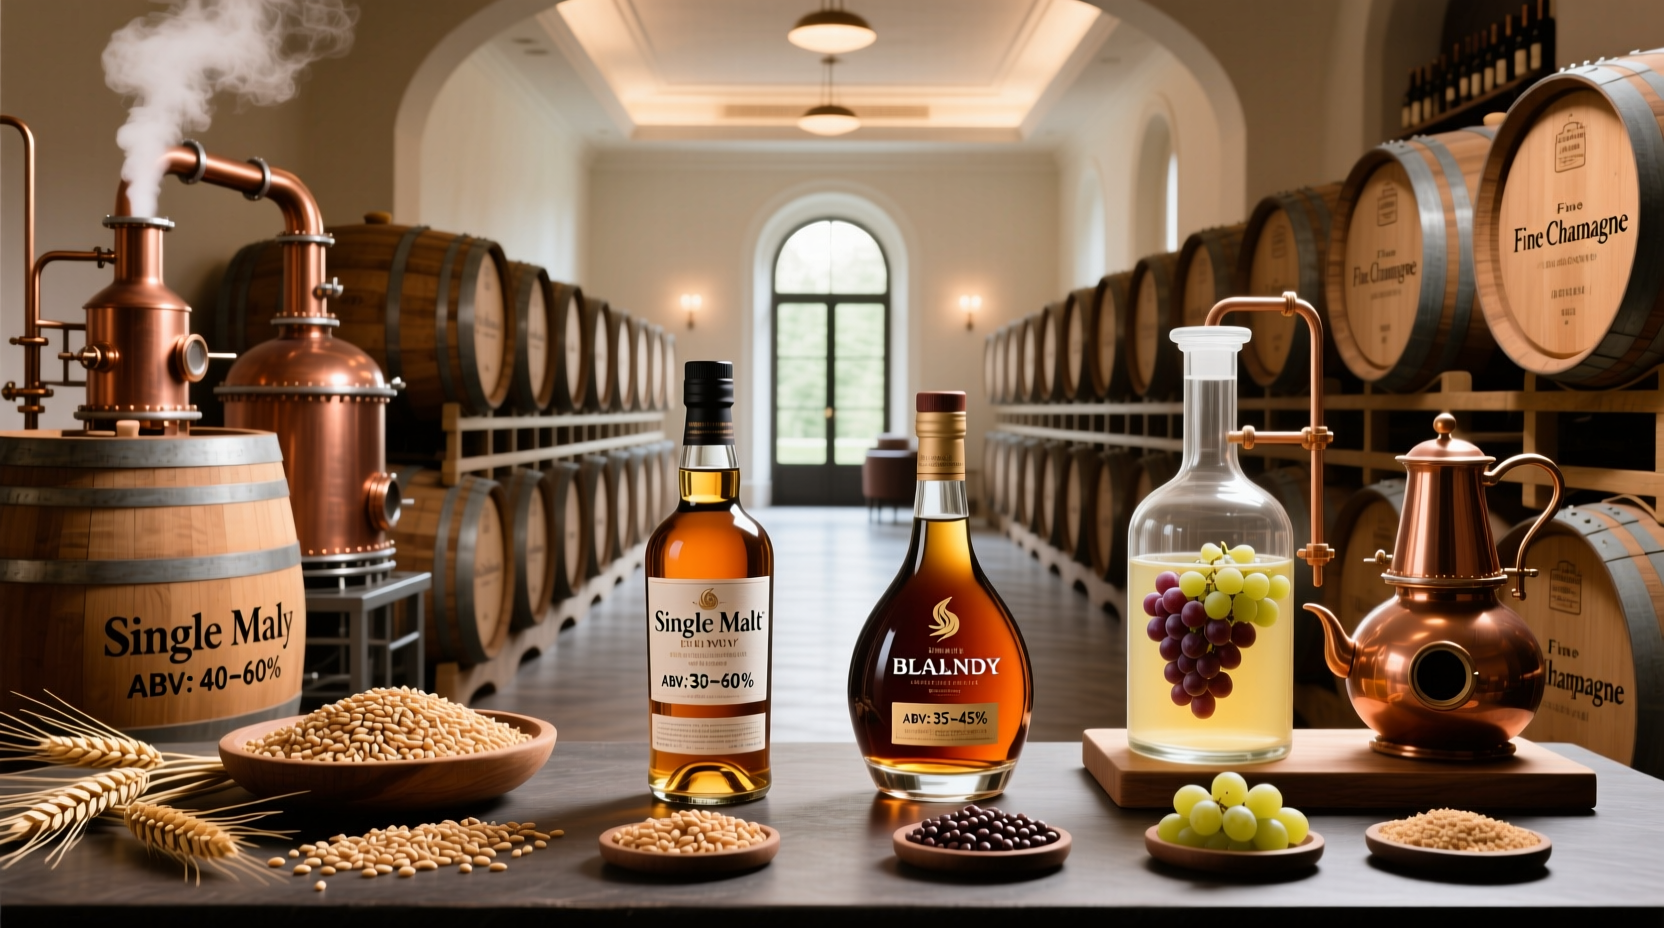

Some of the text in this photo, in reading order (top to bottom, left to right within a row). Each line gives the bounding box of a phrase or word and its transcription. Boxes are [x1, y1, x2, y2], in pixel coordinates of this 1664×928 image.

[1557, 201, 1583, 215] Fine
[1513, 213, 1629, 253] Fine Chamagne
[104, 602, 294, 664] Single Maly
[655, 610, 763, 639] Single Malt
[127, 671, 194, 699] ABV:
